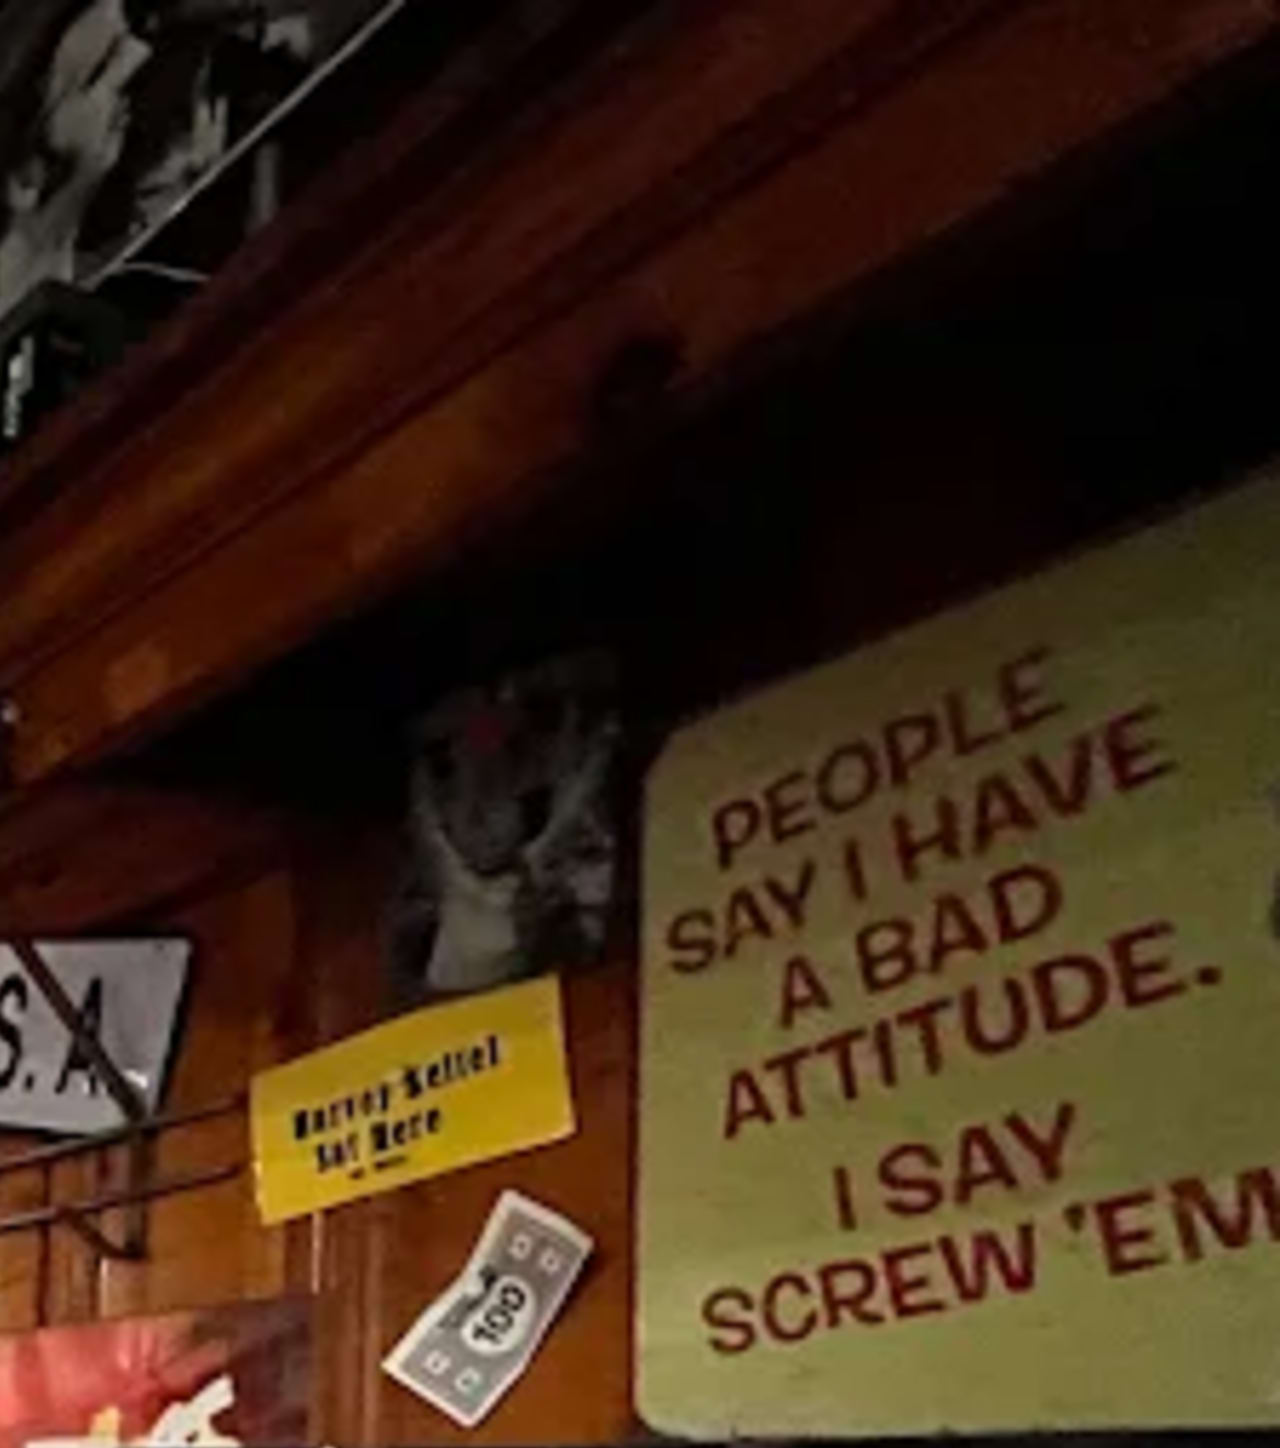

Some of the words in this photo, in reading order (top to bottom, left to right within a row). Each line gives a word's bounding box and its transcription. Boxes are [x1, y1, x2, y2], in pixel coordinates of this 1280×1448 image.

[665, 860, 816, 975] SAY
[843, 840, 867, 901] I
[891, 705, 1177, 881] HAVE
[711, 650, 1067, 871] PEOPLE
[779, 954, 831, 1029] A
[855, 862, 1066, 994] BAD
[722, 919, 1223, 1140] ATTITUDE.
[832, 1167, 858, 1231] I
[876, 1103, 1076, 1219] SAY
[473, 1284, 526, 1345] 100
[700, 1224, 1037, 1357] SCREW
